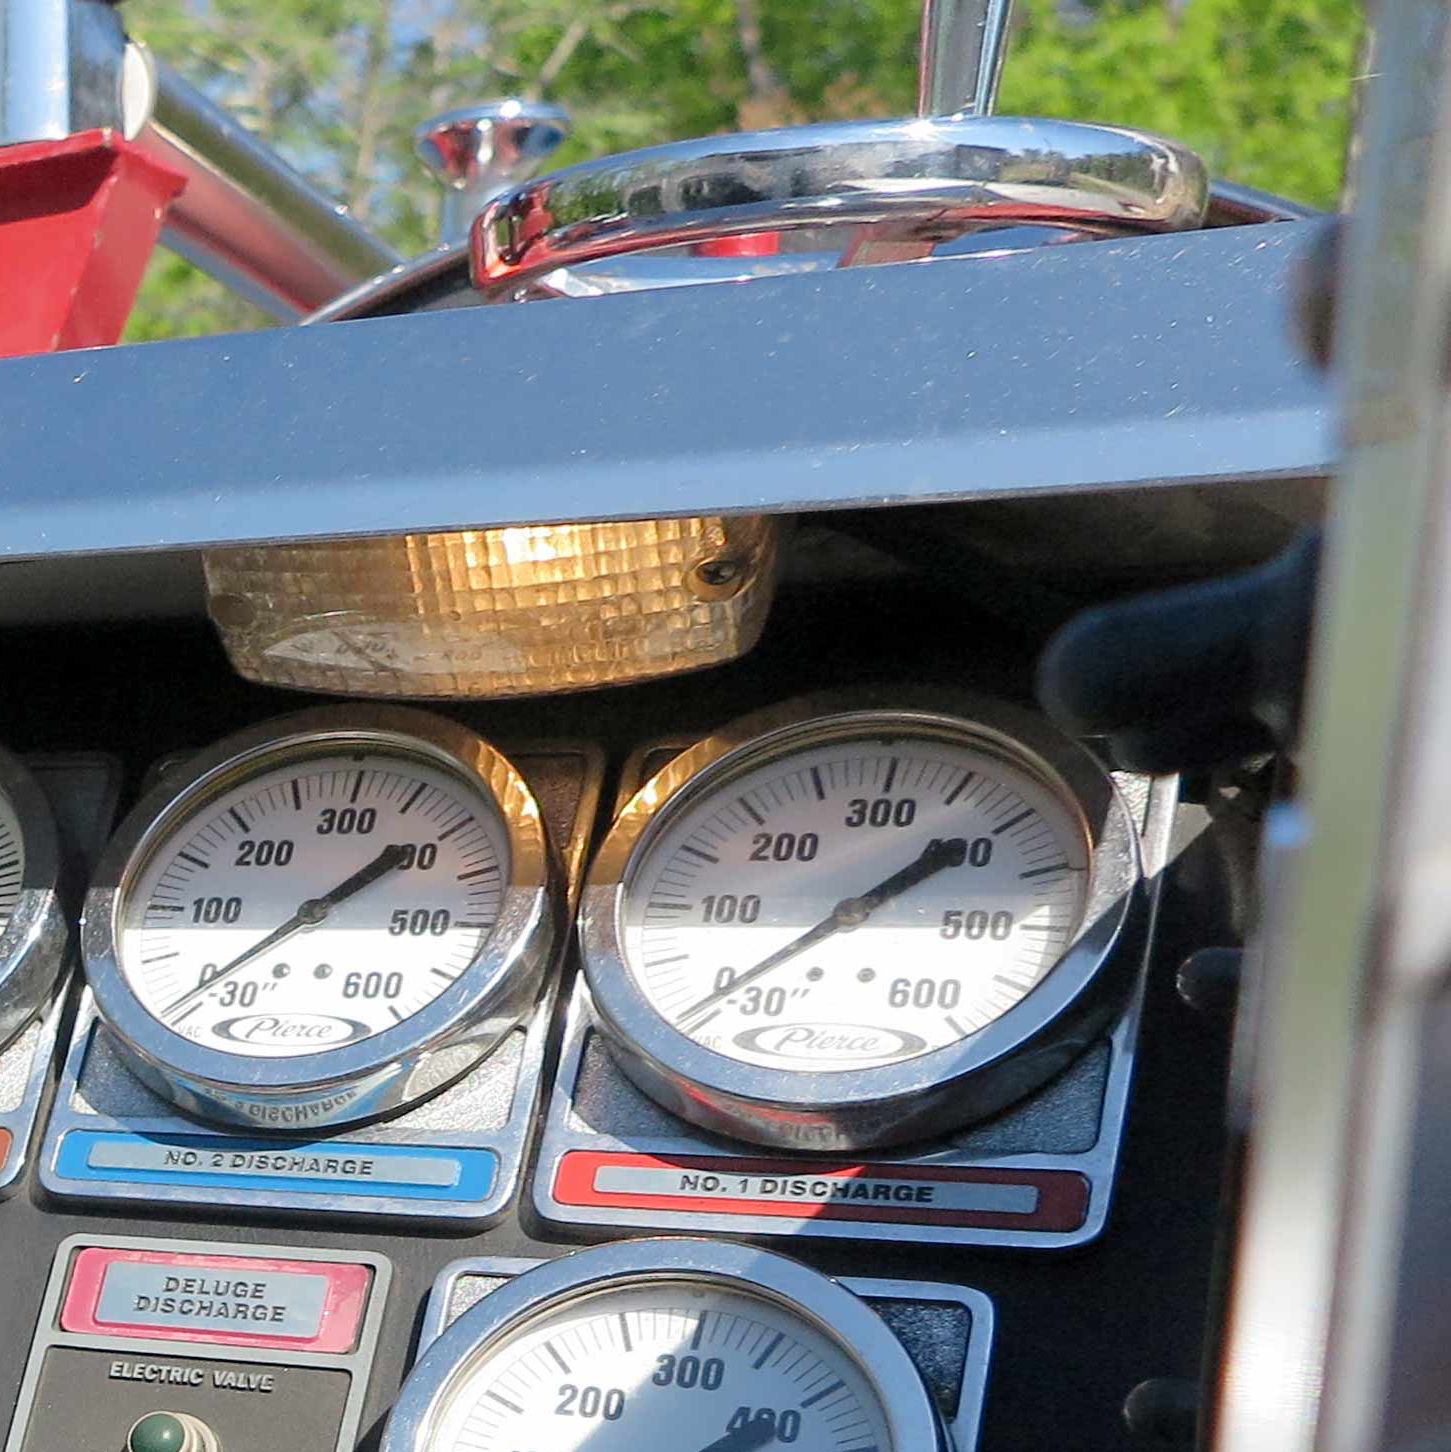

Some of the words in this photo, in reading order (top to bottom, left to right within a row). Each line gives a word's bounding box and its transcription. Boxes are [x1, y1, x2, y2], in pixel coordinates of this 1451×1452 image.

[316, 807, 377, 836] 300
[845, 798, 916, 828] 300
[234, 840, 295, 867] 200
[748, 832, 819, 862] 200
[192, 897, 242, 924] 100
[388, 909, 451, 937] 500
[701, 894, 761, 924] 100
[939, 910, 1014, 941] 500
[341, 971, 404, 999] 600
[888, 978, 962, 1010] 600
[244, 1017, 334, 1040] Pierce
[774, 1027, 881, 1054] Pierce
[163, 1149, 204, 1170] NO.
[209, 1154, 225, 1169] 2
[230, 1154, 375, 1178] DISCHARGE
[678, 1173, 728, 1195] NO.
[736, 1177, 748, 1195] 1
[759, 1177, 935, 1204] DISCHARGE
[162, 1276, 268, 1299] DELUGE
[133, 1295, 287, 1323] DISCHARGE
[108, 1361, 204, 1387] ELECTRIC
[212, 1370, 275, 1392] VALVE
[651, 1353, 725, 1392] 300
[554, 1384, 626, 1421] 200
